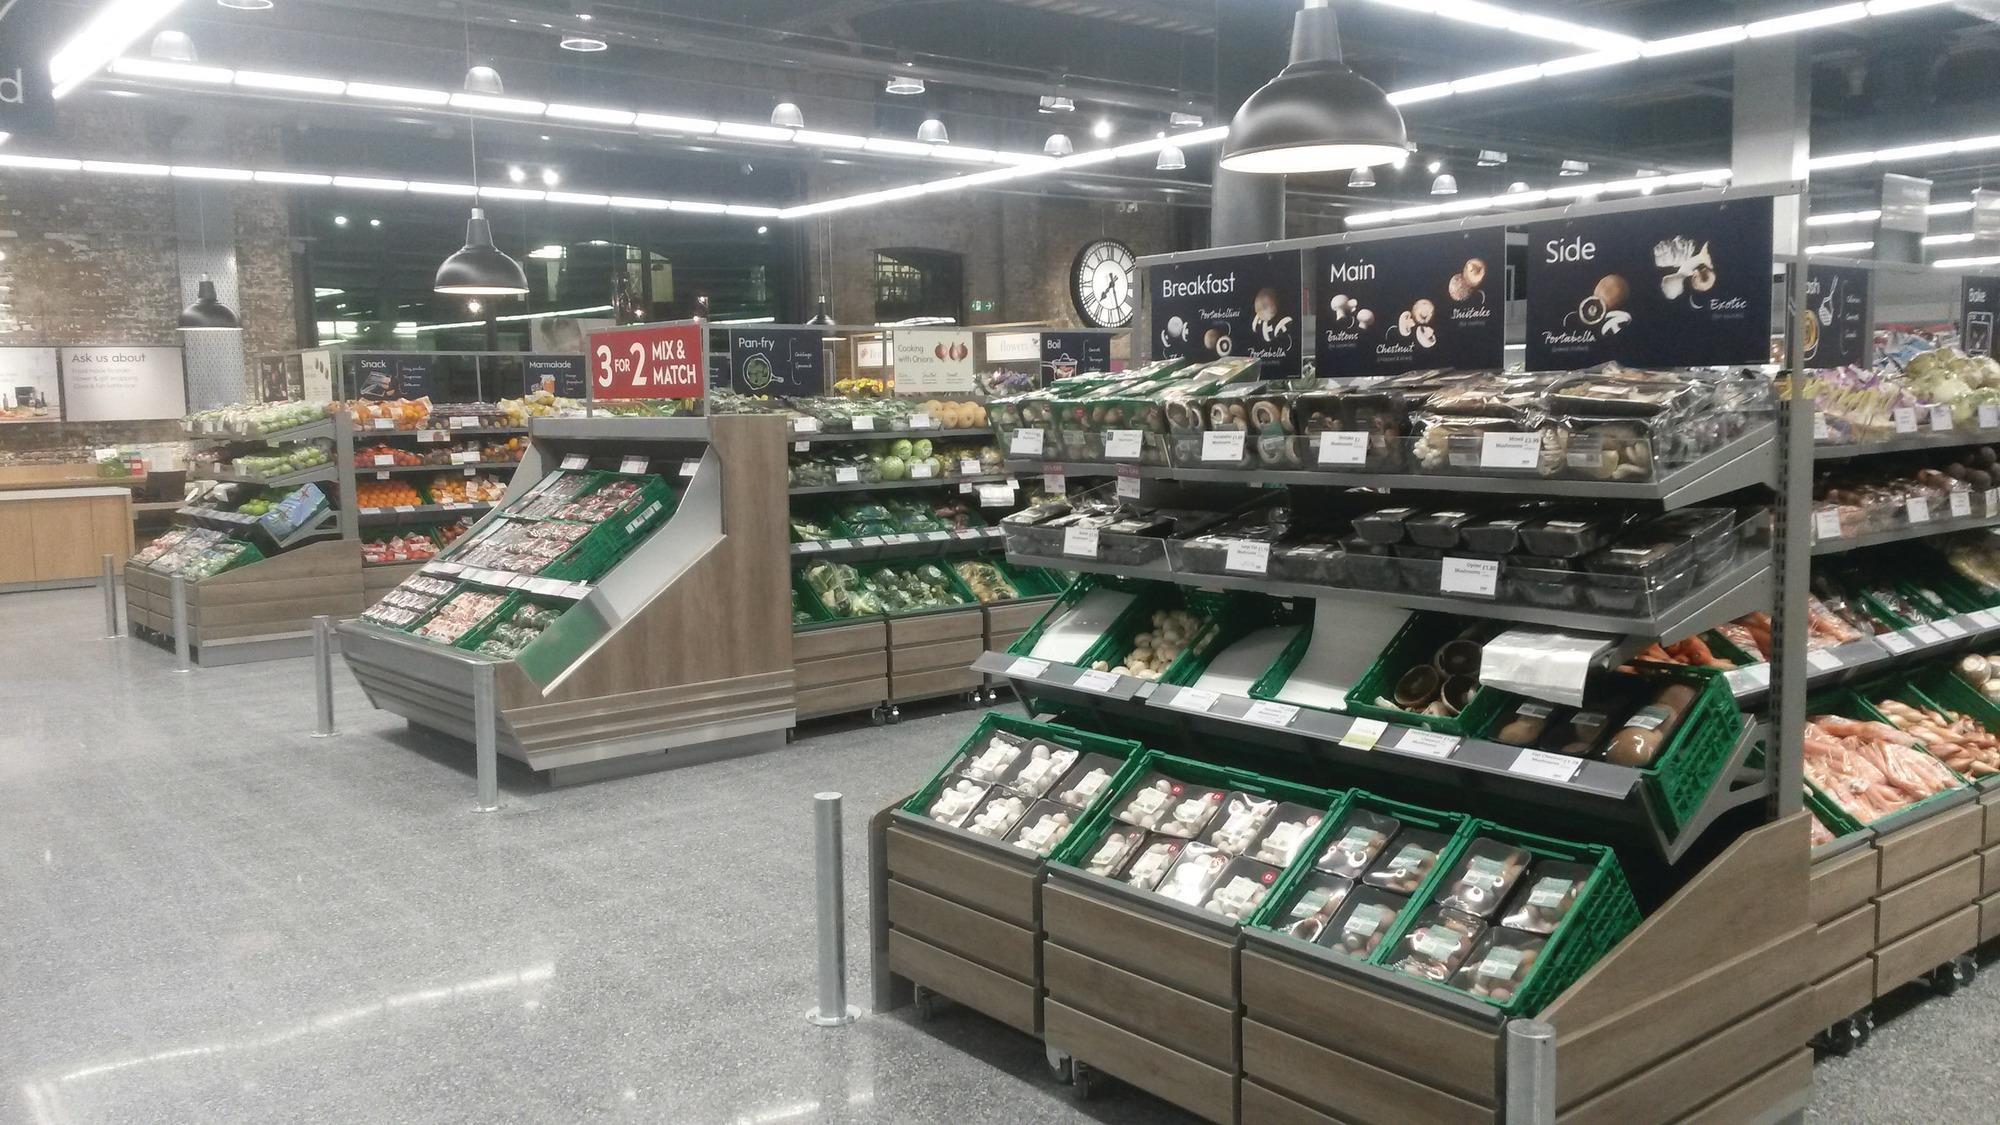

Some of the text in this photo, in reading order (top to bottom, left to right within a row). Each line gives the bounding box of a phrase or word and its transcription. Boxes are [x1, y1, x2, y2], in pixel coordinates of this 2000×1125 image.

[1546, 235, 1597, 264] Side
[1330, 258, 1376, 283] Main
[1162, 271, 1236, 298] Breakfast
[1710, 297, 1748, 311] Exotic
[1325, 329, 1359, 343] Buttons
[1541, 330, 1597, 345] Portabella
[652, 339, 686, 361] MIX &
[738, 336, 775, 351] Pan-fry
[897, 344, 924, 354] Cooking
[1047, 339, 1061, 349] Boil
[1376, 342, 1415, 354] Chestnut
[71, 352, 146, 363] Ask us about
[361, 360, 387, 368] Snack
[529, 360, 572, 369] Marmalade
[898, 355, 911, 364] with
[912, 355, 934, 364] Onions
[596, 342, 648, 388] 3 FOR 2
[653, 364, 697, 385] MATCH
